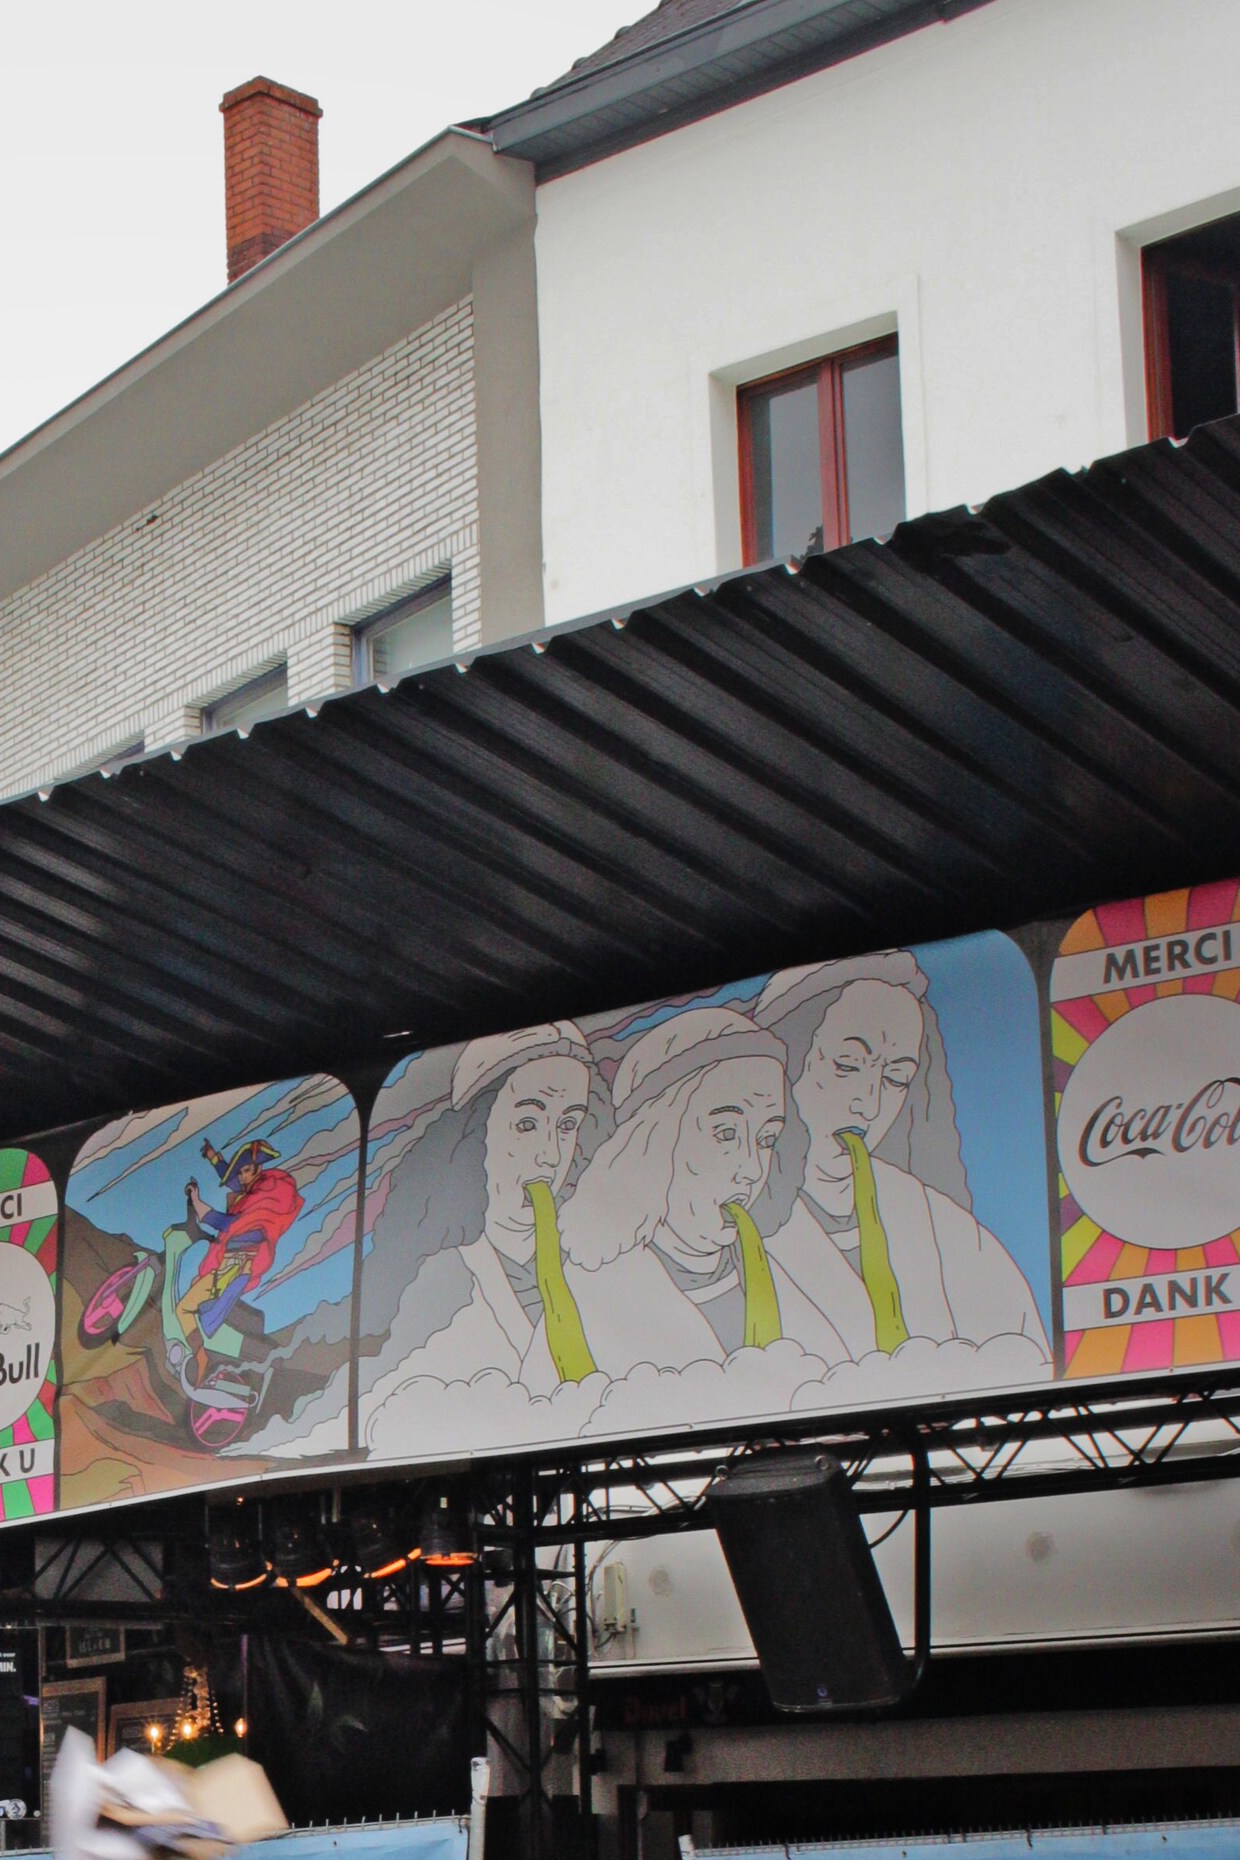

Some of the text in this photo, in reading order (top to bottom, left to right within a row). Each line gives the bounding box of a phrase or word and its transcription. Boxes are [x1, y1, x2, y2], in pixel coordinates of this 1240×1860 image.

[1102, 930, 1233, 985] MERCI
[1079, 1077, 1240, 1167] Coca-Col
[1102, 1272, 1233, 1319] DANK
[18, 1448, 35, 1473] U
